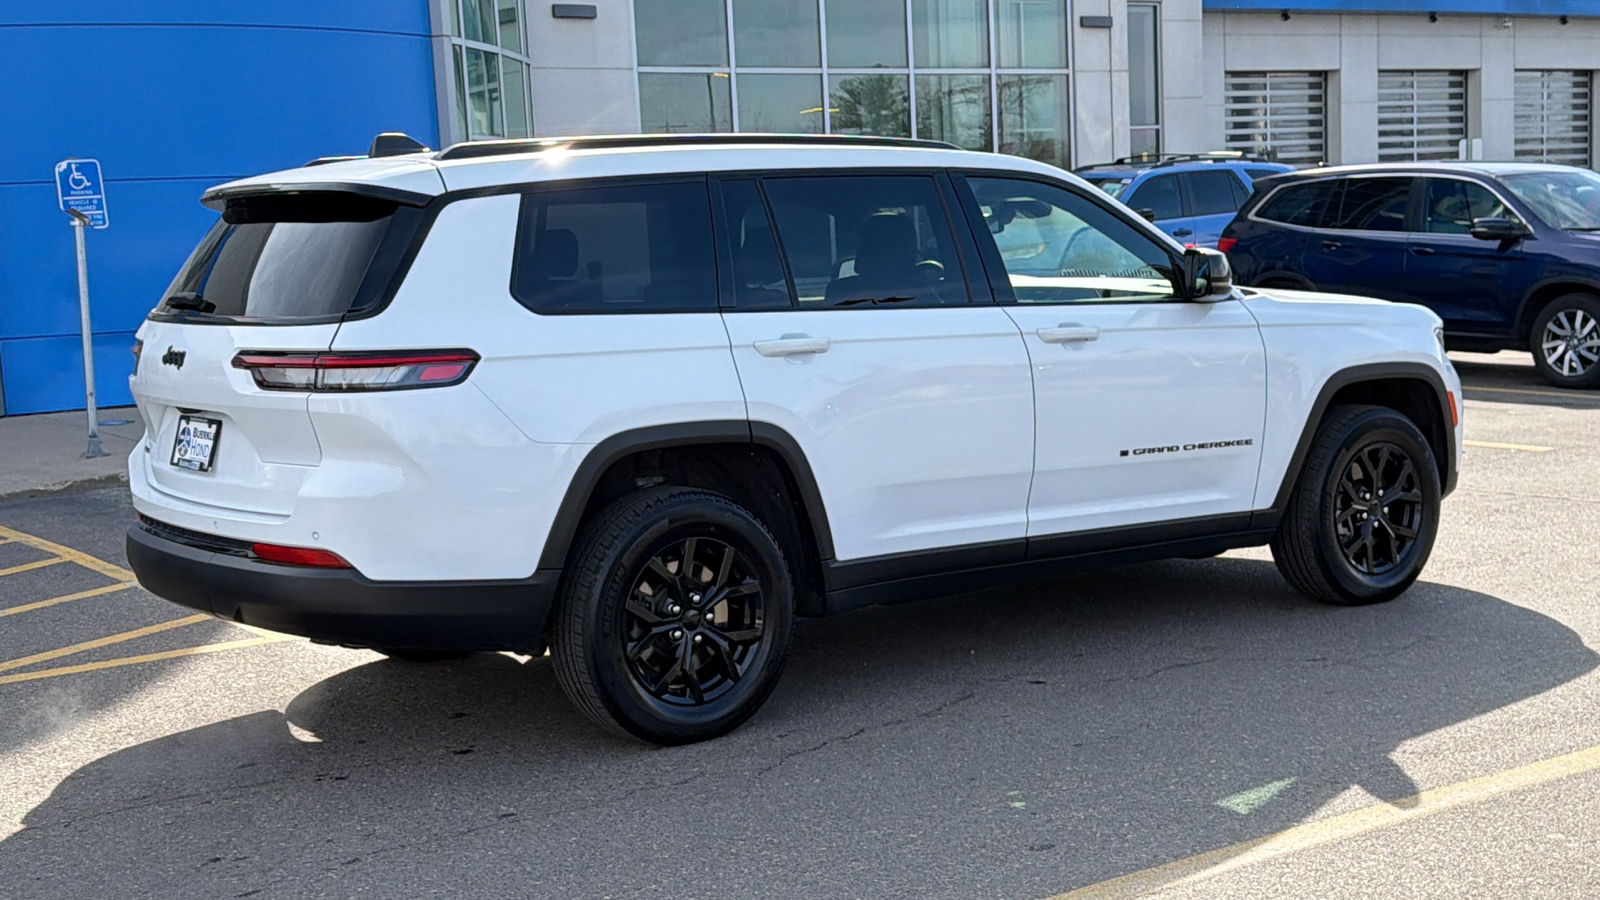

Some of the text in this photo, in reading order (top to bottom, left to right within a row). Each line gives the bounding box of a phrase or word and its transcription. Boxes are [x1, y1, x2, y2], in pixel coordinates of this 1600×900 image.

[162, 345, 187, 371] Jeep
[193, 427, 213, 441] BUERKL
[189, 438, 210, 458] HOND
[1133, 439, 1254, 456] GRAND CHEROKEE
